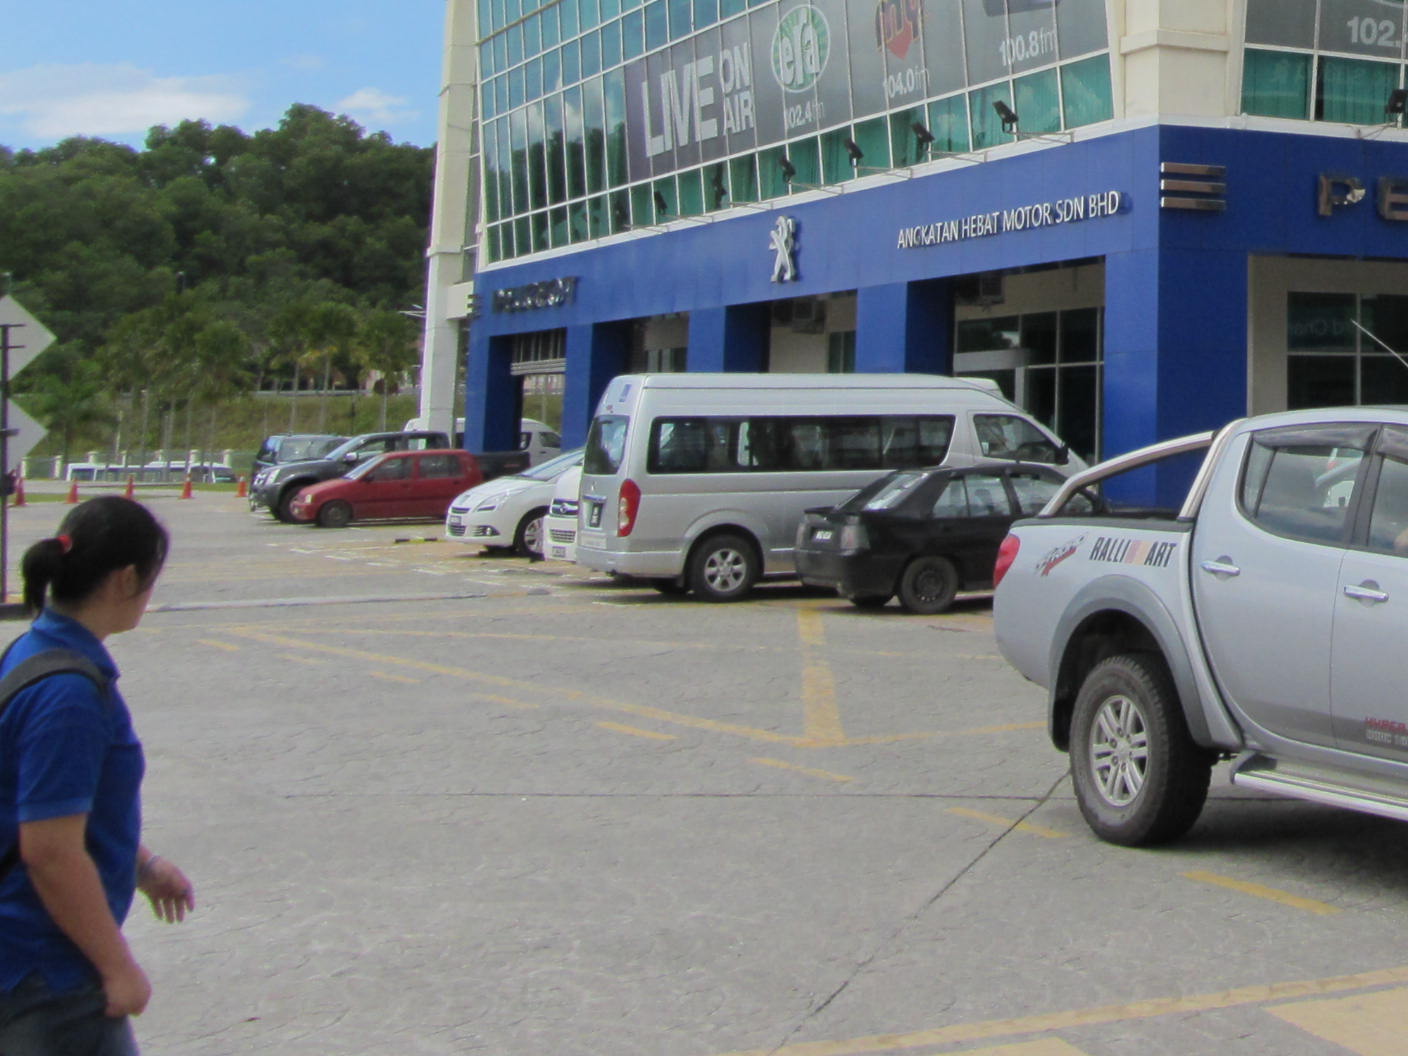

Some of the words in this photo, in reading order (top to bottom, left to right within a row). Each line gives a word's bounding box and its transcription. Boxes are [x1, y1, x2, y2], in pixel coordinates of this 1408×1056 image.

[780, 6, 820, 86] era
[642, 56, 718, 158] LIVE
[719, 42, 750, 94] ON
[723, 89, 756, 136] AIR
[898, 219, 959, 249] ANGKATAN
[961, 211, 1000, 239] HEBAT
[1002, 202, 1051, 232] MOTOR
[1055, 195, 1085, 224] SDN
[1088, 190, 1119, 217] BHD
